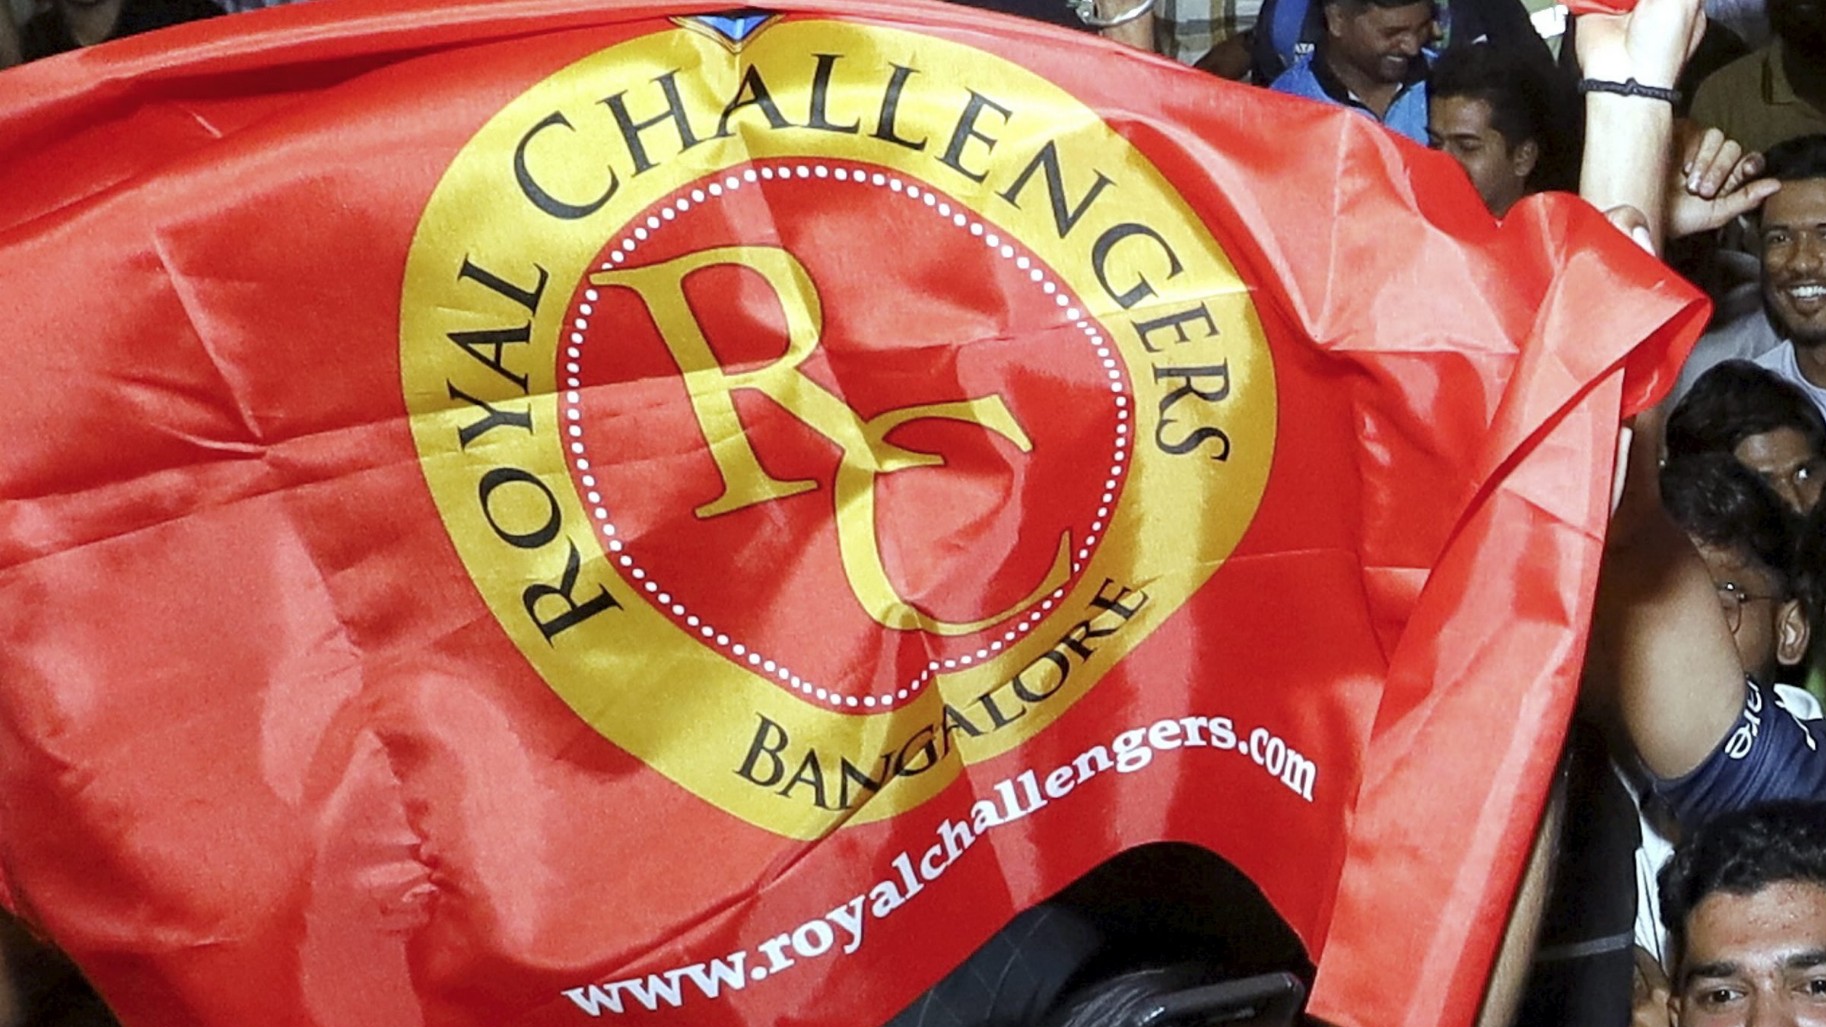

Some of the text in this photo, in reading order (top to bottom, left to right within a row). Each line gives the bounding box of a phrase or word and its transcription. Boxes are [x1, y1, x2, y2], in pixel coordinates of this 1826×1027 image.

[446, 53, 1231, 648] ROYAL CHALLENGERS
[736, 577, 1150, 809] BANGALORE
[562, 714, 1318, 1019] www.royalchallengers.com
